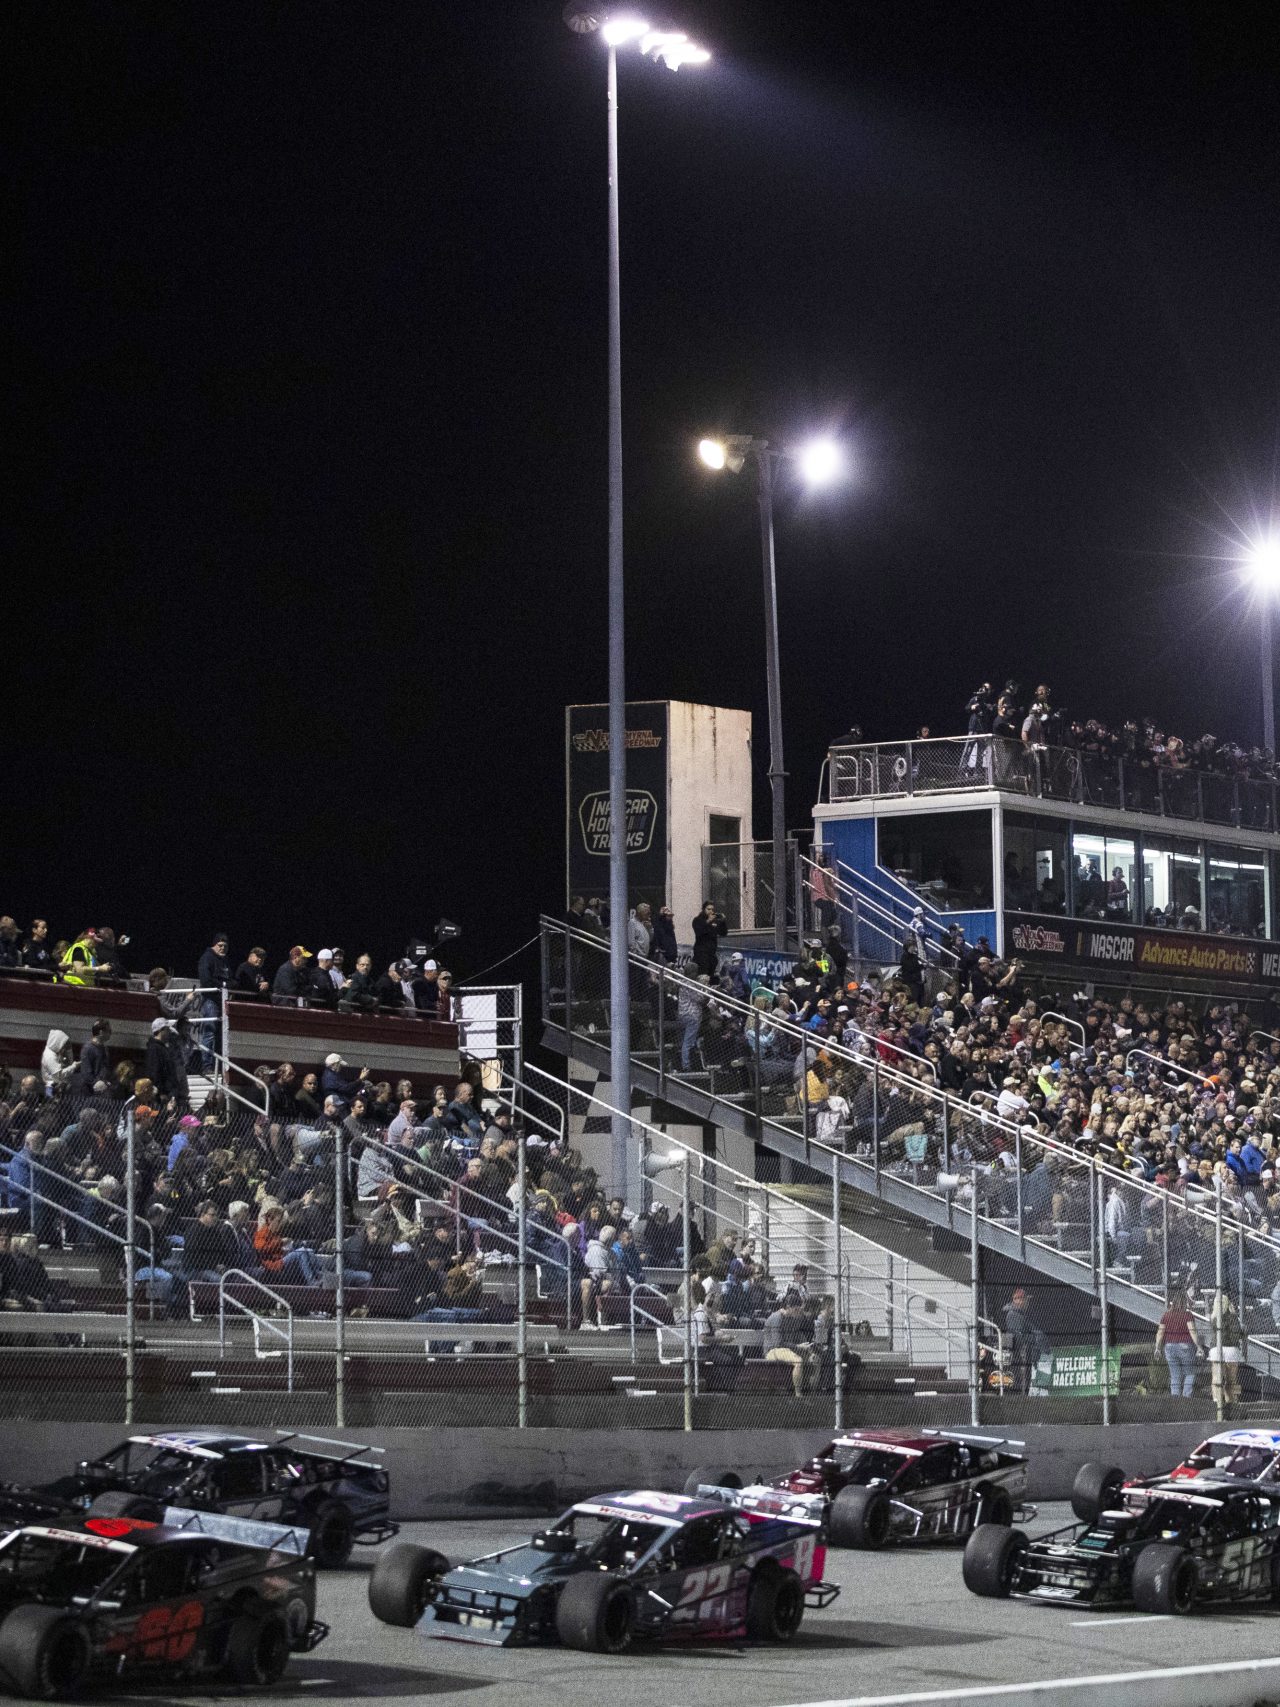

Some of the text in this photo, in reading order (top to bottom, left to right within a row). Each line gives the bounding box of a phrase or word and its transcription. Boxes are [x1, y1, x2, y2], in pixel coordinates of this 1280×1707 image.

[595, 798, 649, 815] NACAR
[592, 832, 644, 849] TRKS
[1090, 934, 1134, 962] NASCAR
[1141, 941, 1188, 965] Advance
[1190, 945, 1217, 969] Auto
[1217, 948, 1247, 973] Parts
[744, 957, 799, 977] WELCOM
[1056, 1356, 1097, 1371] WELCOME
[1052, 1371, 1098, 1386] RACE FANS
[671, 1564, 732, 1621] 22
